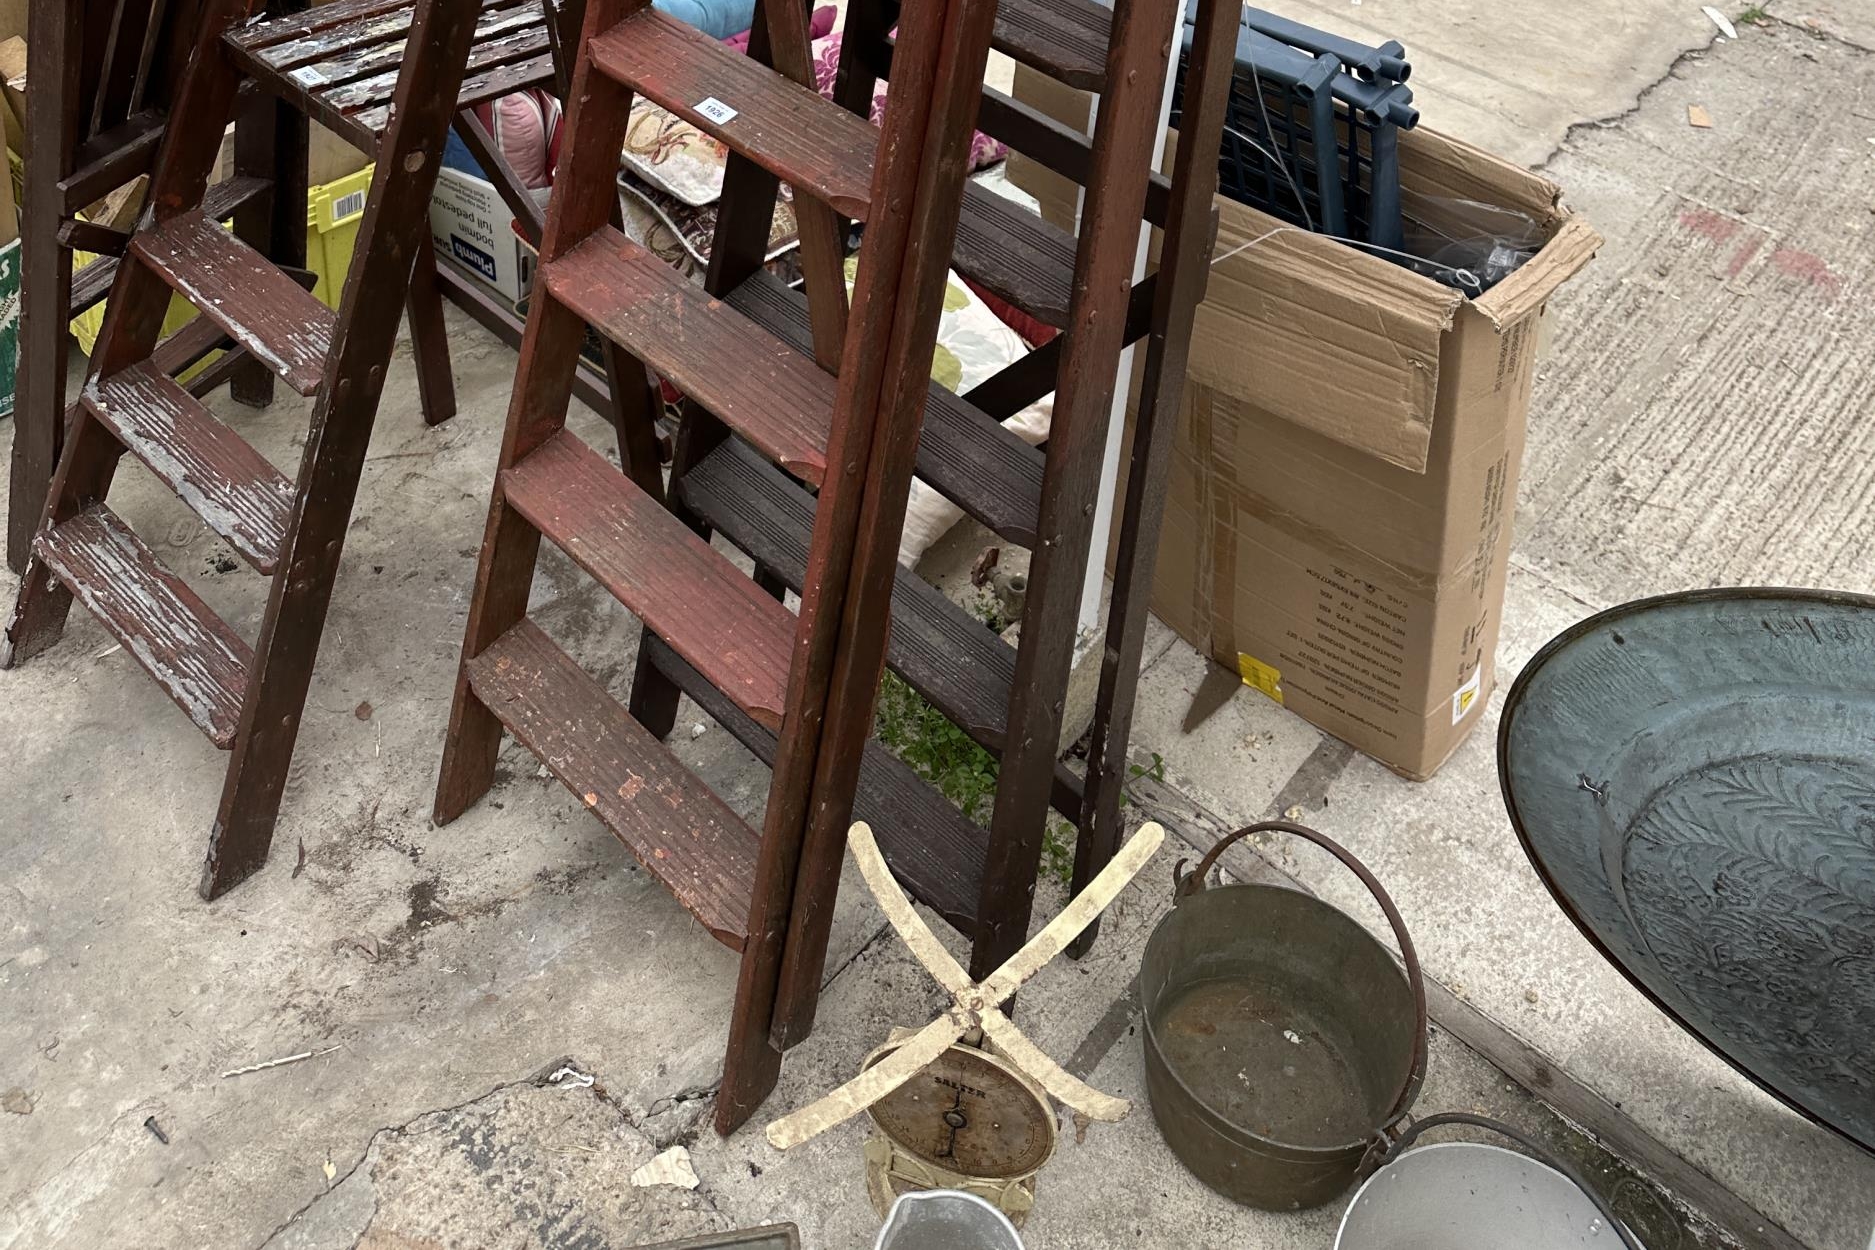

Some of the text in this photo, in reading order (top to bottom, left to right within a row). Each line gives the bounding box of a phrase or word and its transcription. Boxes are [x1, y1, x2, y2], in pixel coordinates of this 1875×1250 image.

[704, 104, 726, 119] 1926
[458, 222, 495, 250] bodmin
[477, 216, 493, 234] full
[454, 241, 494, 277] Plumb
[934, 1076, 986, 1099] SALTER
